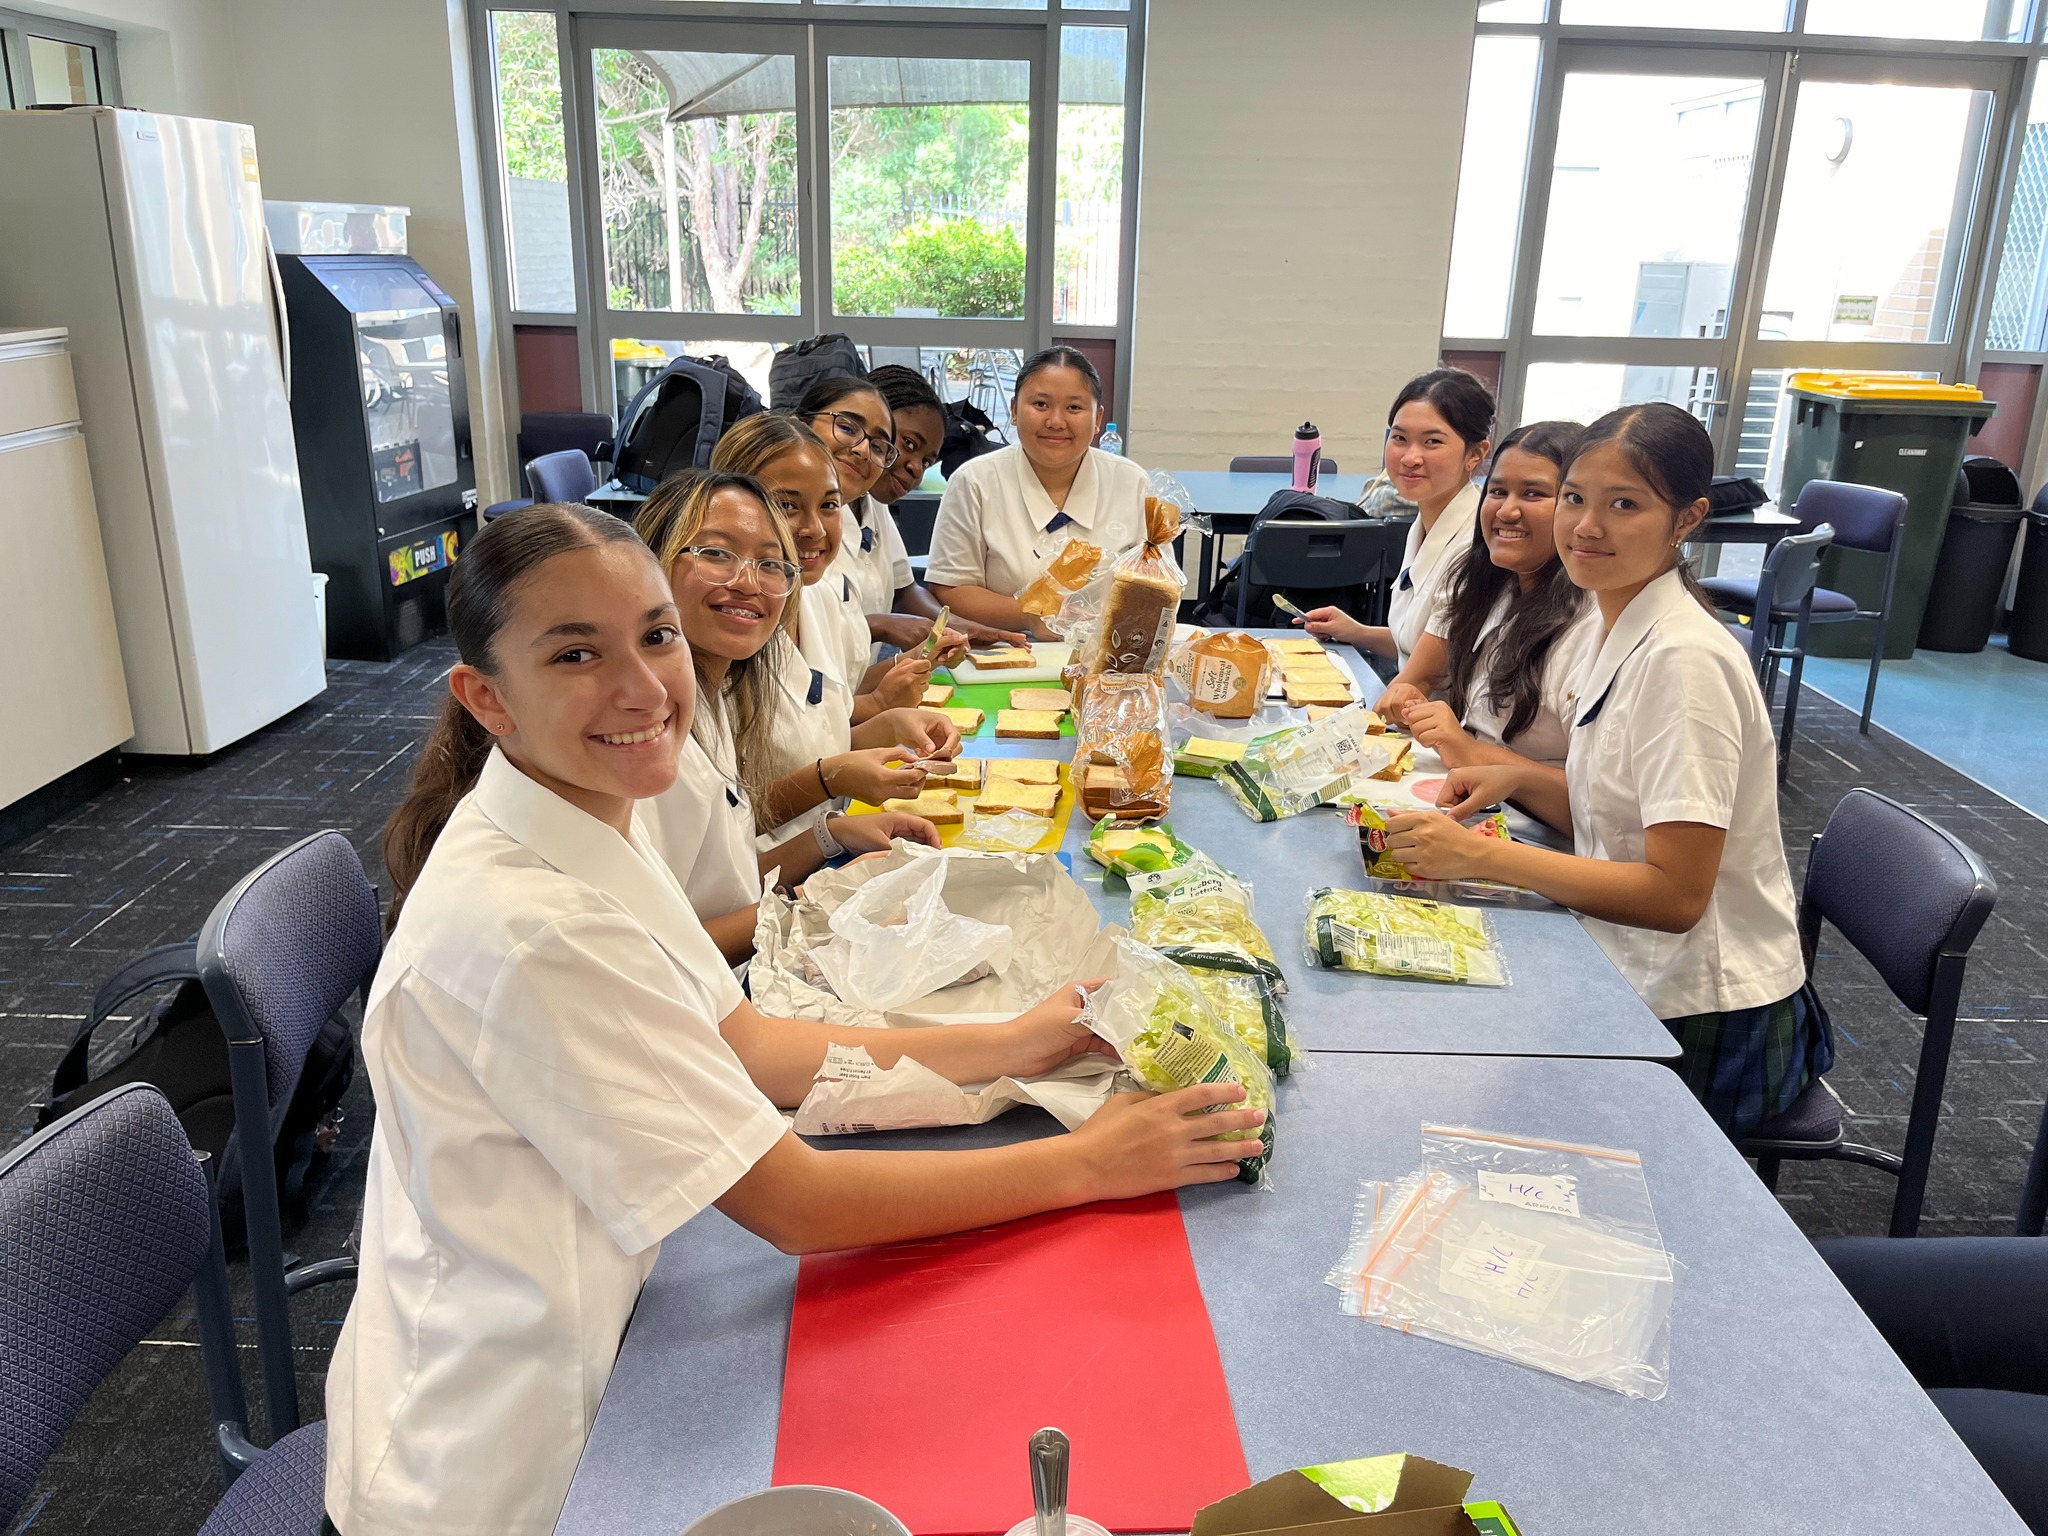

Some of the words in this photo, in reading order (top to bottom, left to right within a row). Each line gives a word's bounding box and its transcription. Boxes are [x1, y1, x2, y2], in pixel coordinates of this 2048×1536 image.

[414, 546, 436, 567] PUSH
[1206, 670, 1217, 689] Soft
[1213, 660, 1226, 700] Wholemeal
[1220, 664, 1232, 699] Sandwich
[1190, 879, 1222, 892] Iceberg
[1190, 886, 1223, 897] Lettuce
[1509, 1184, 1543, 1199] H/C
[1525, 1202, 1572, 1213] ARMADA
